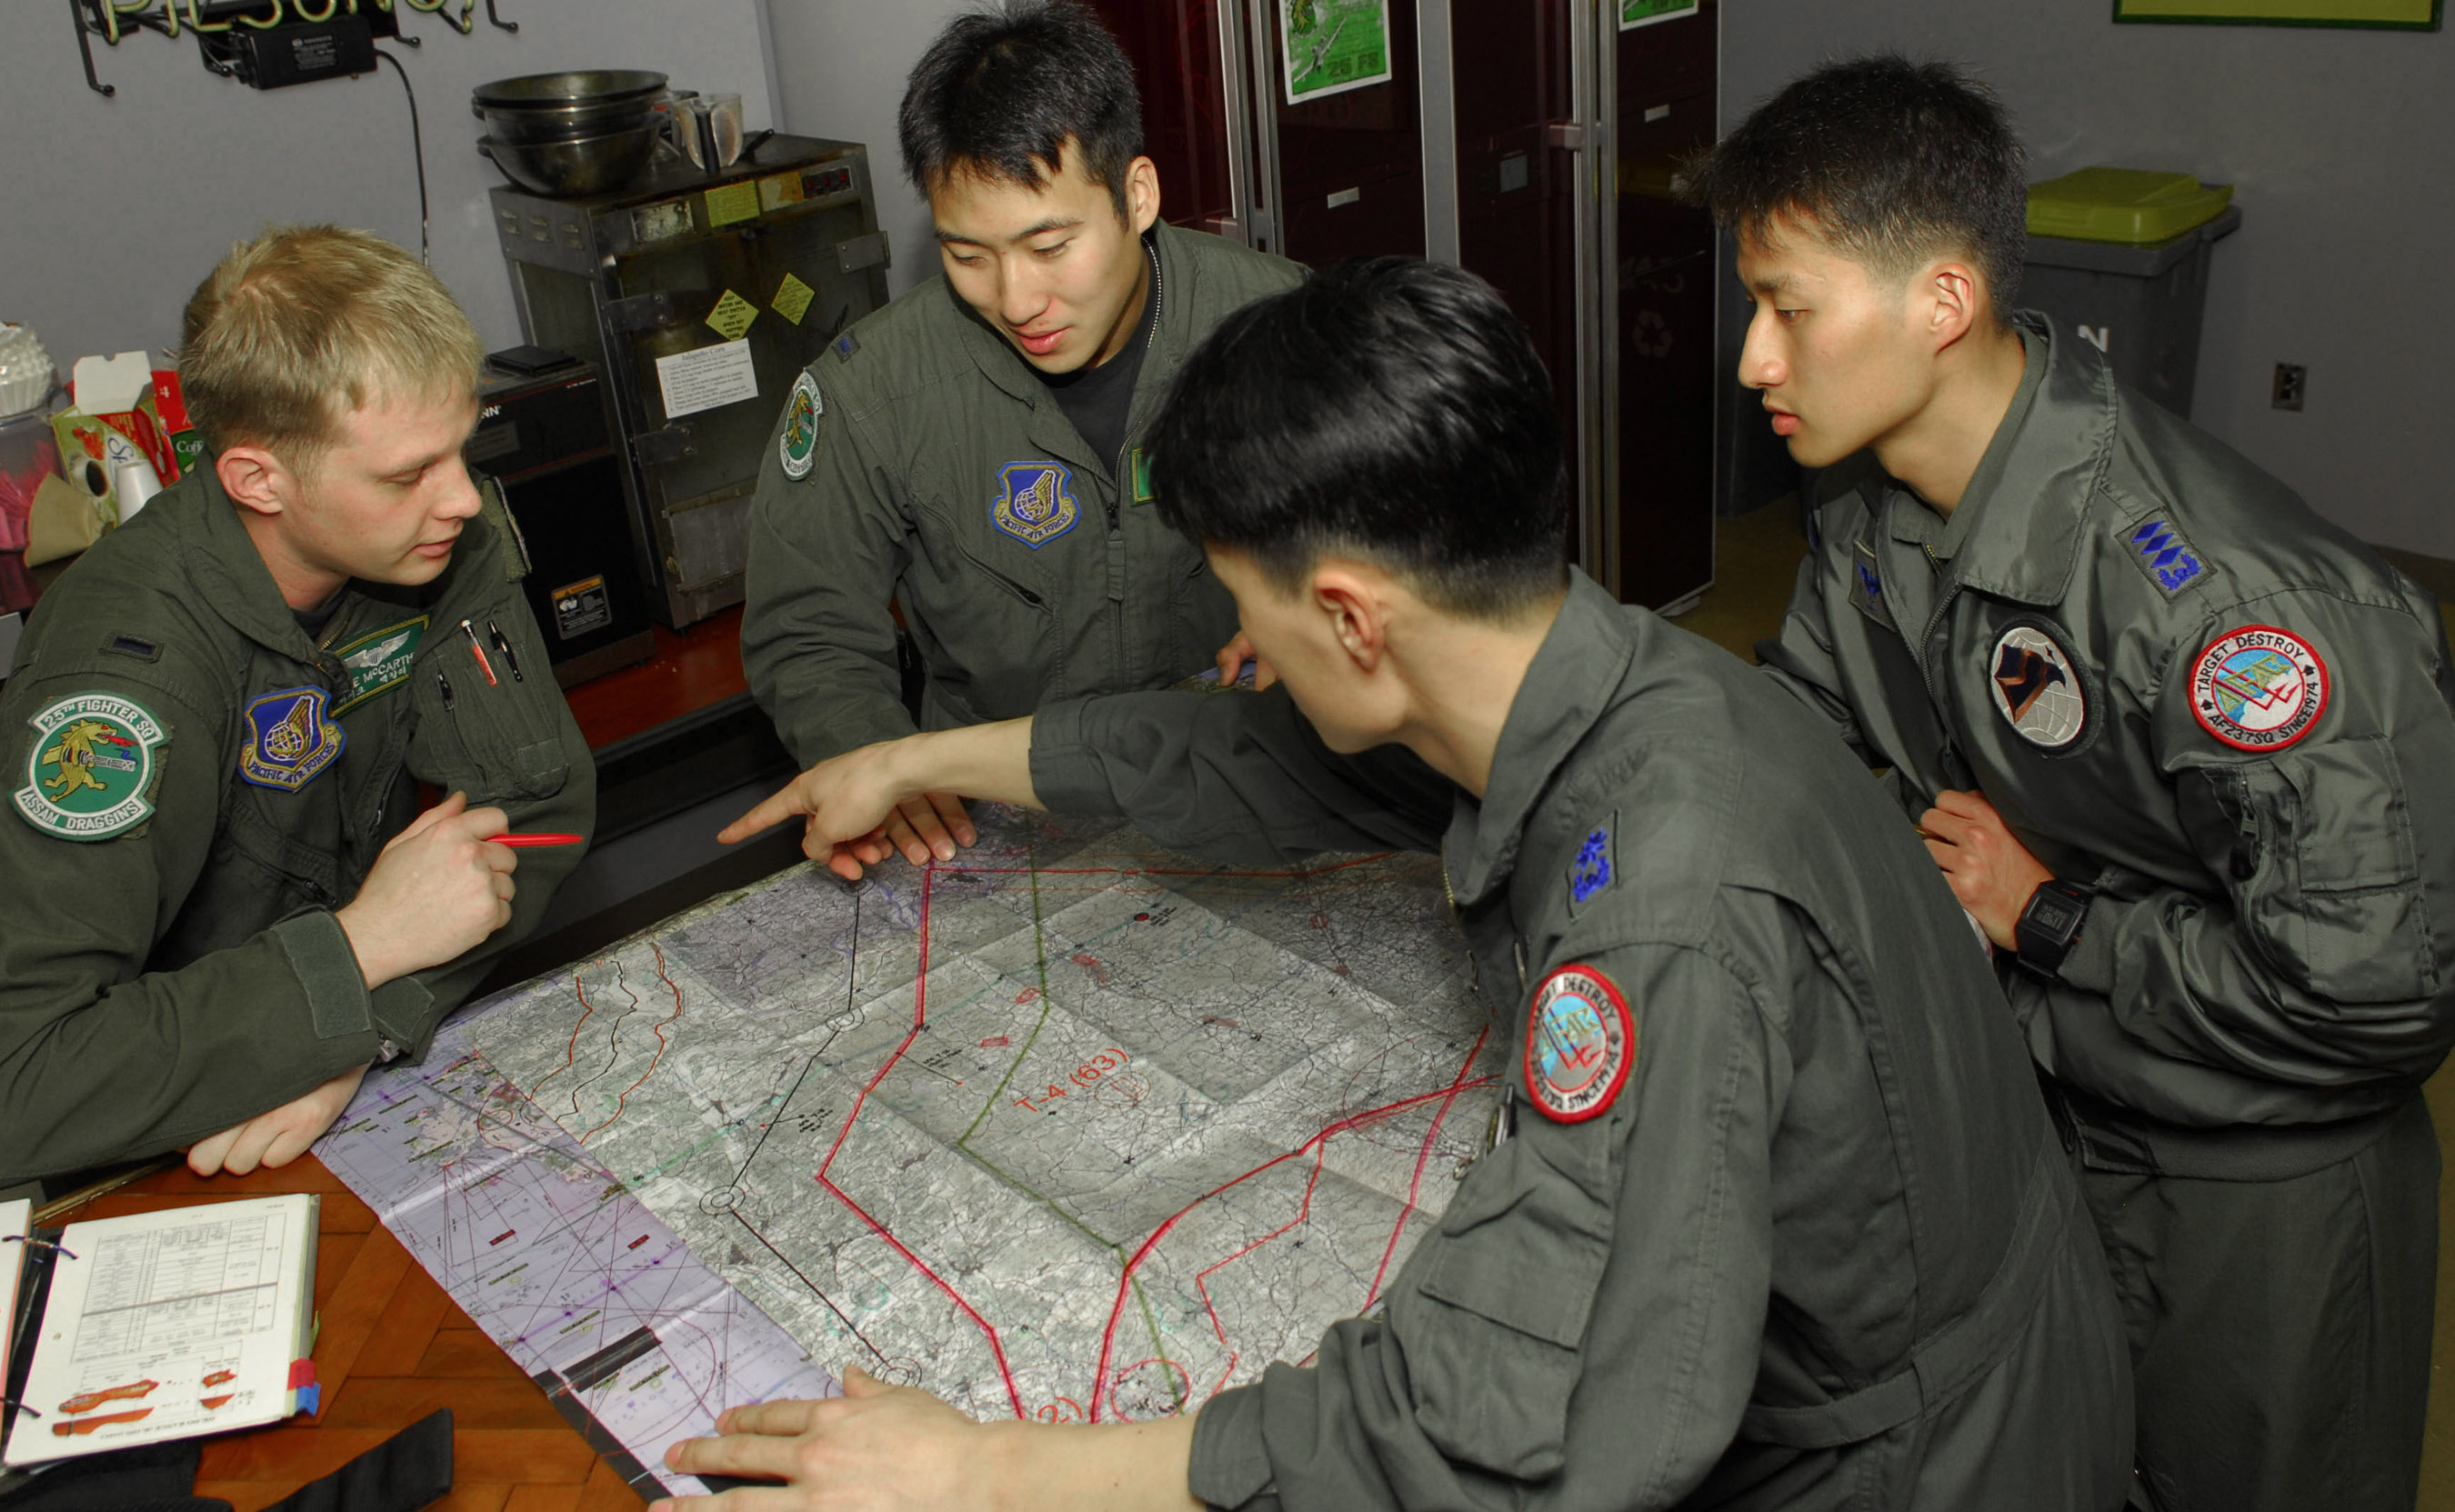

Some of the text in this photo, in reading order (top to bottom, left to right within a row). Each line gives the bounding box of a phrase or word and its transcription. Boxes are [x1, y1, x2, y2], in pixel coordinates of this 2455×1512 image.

[1000, 512, 1070, 539] PACIFIC AIR FORCES
[2198, 634, 2304, 693] TARGET DESTROY
[77, 700, 137, 725] FIGHTER
[136, 719, 155, 739] SQ
[248, 742, 336, 784] PACIFIC AIR FORCES
[22, 793, 139, 831] ASSAM DRAGGINS
[1563, 976, 1617, 1018] DESTROY
[1013, 1047, 1128, 1113] T-4 (63)
